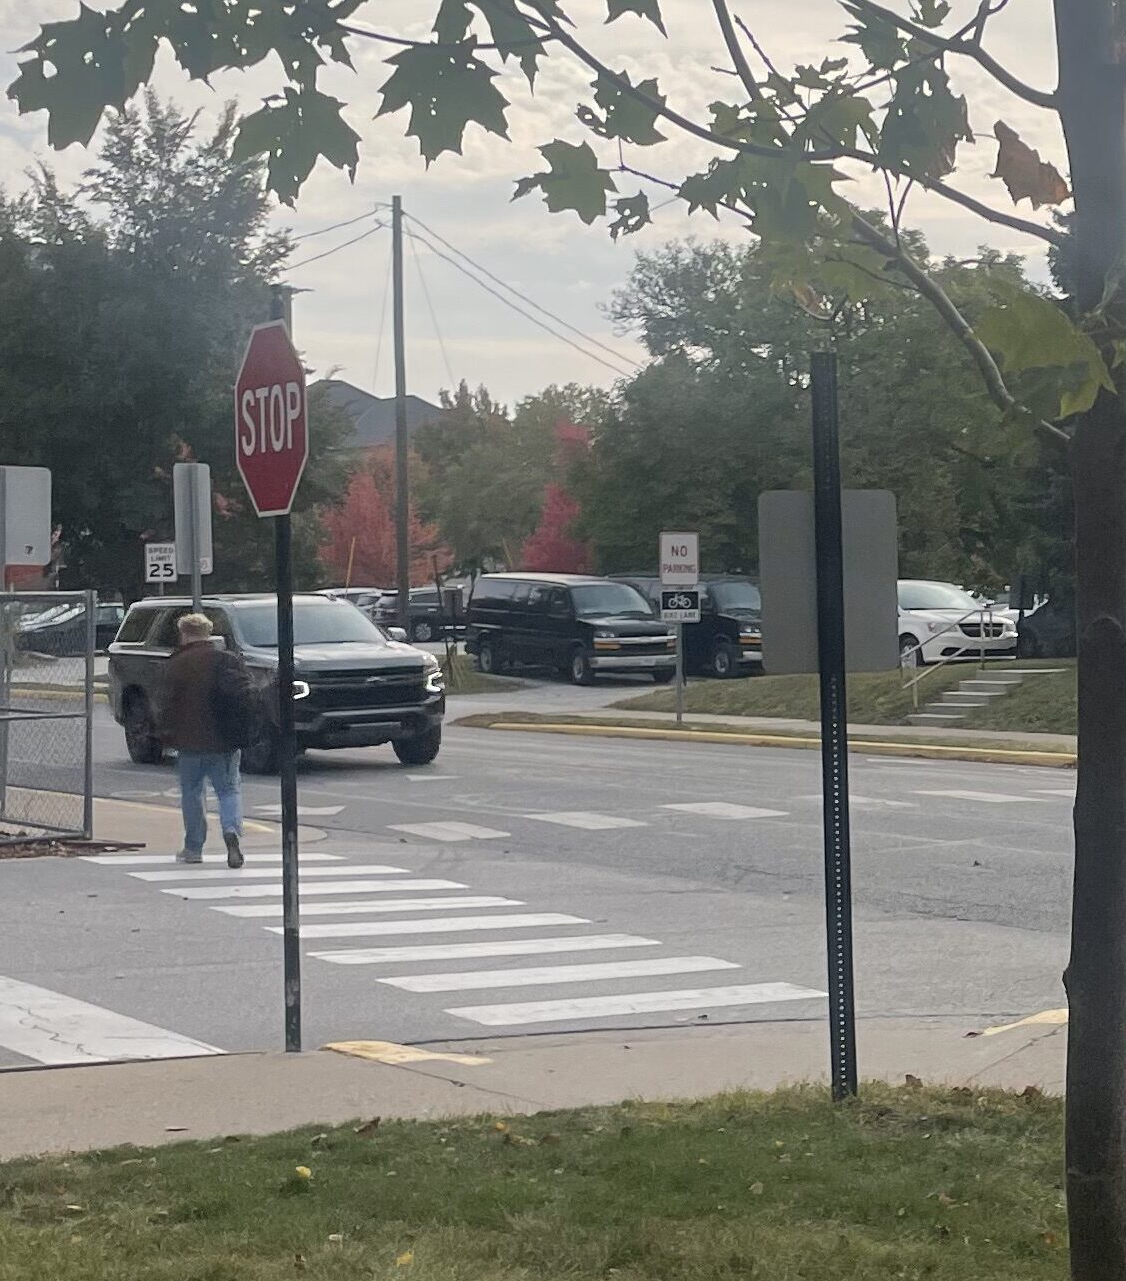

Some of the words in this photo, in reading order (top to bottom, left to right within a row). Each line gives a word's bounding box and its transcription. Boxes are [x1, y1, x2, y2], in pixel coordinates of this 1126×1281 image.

[241, 382, 301, 456] STOP
[671, 545, 688, 557] NO
[149, 563, 174, 578] 25
[663, 564, 697, 574] PARKING
[680, 611, 697, 619] LANE
